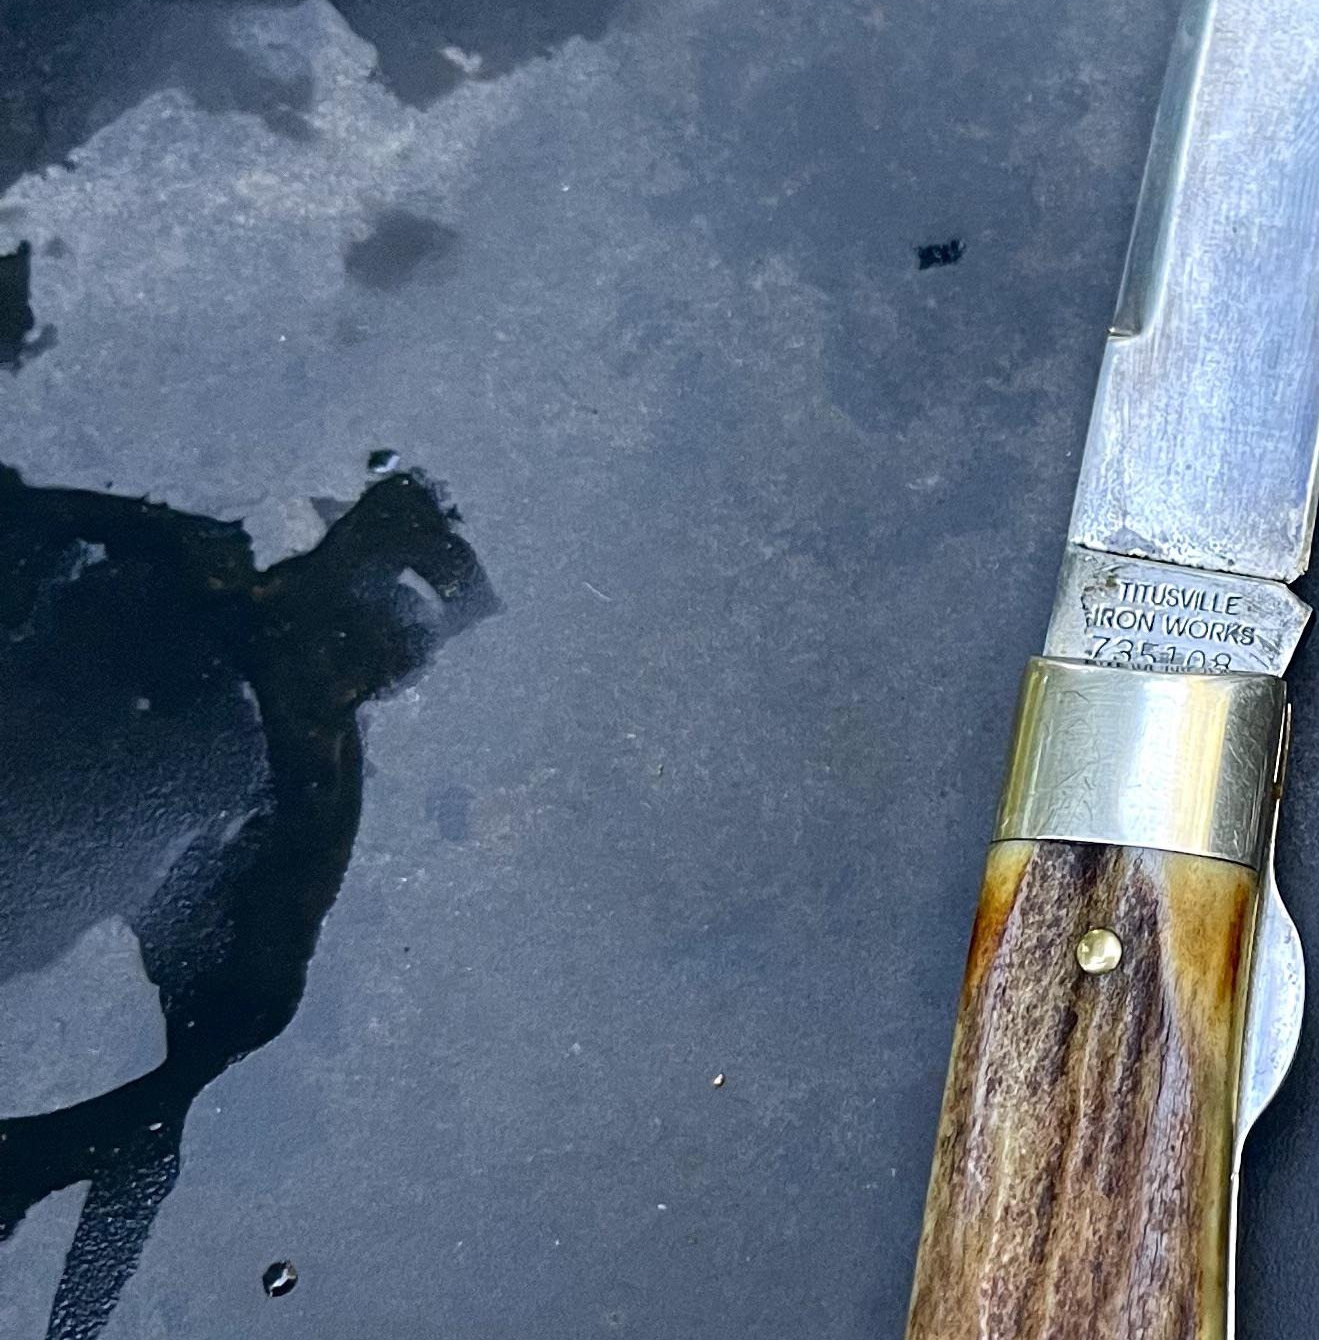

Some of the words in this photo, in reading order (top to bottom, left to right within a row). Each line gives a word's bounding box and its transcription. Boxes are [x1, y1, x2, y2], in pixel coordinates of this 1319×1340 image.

[1117, 581, 1243, 616] TITUSVILLE
[1089, 608, 1155, 635] IRON
[1164, 614, 1256, 645] WORKS
